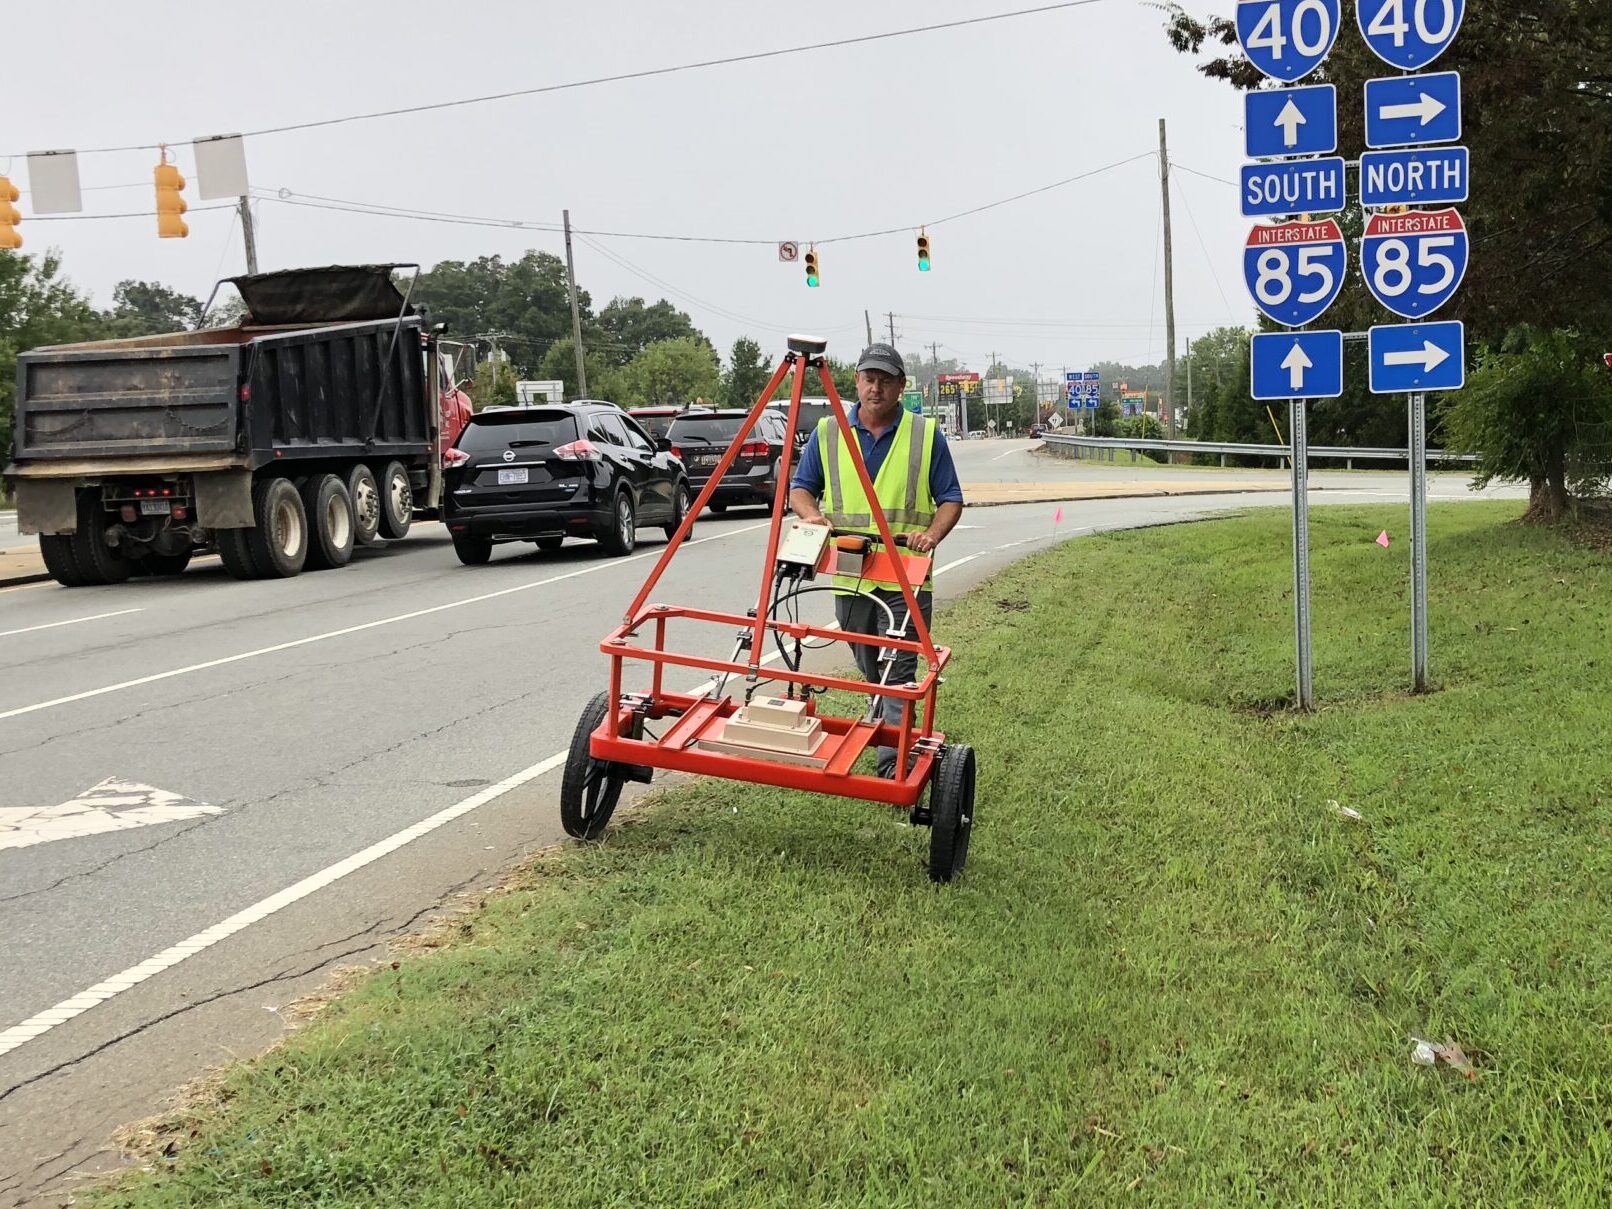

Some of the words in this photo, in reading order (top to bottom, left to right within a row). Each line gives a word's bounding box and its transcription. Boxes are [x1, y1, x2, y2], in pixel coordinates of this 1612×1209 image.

[1246, 0, 1331, 60] 40
[1367, 0, 1455, 47] 40
[1246, 169, 1337, 205] SOUTH
[1367, 159, 1461, 193] NORTH
[1257, 225, 1329, 243] INTERSTATE
[1376, 216, 1451, 234] INTERSTATE
[1254, 246, 1334, 305] 85
[1373, 236, 1456, 297] 85
[1069, 385, 1082, 394] 40
[1086, 384, 1098, 394] 85
